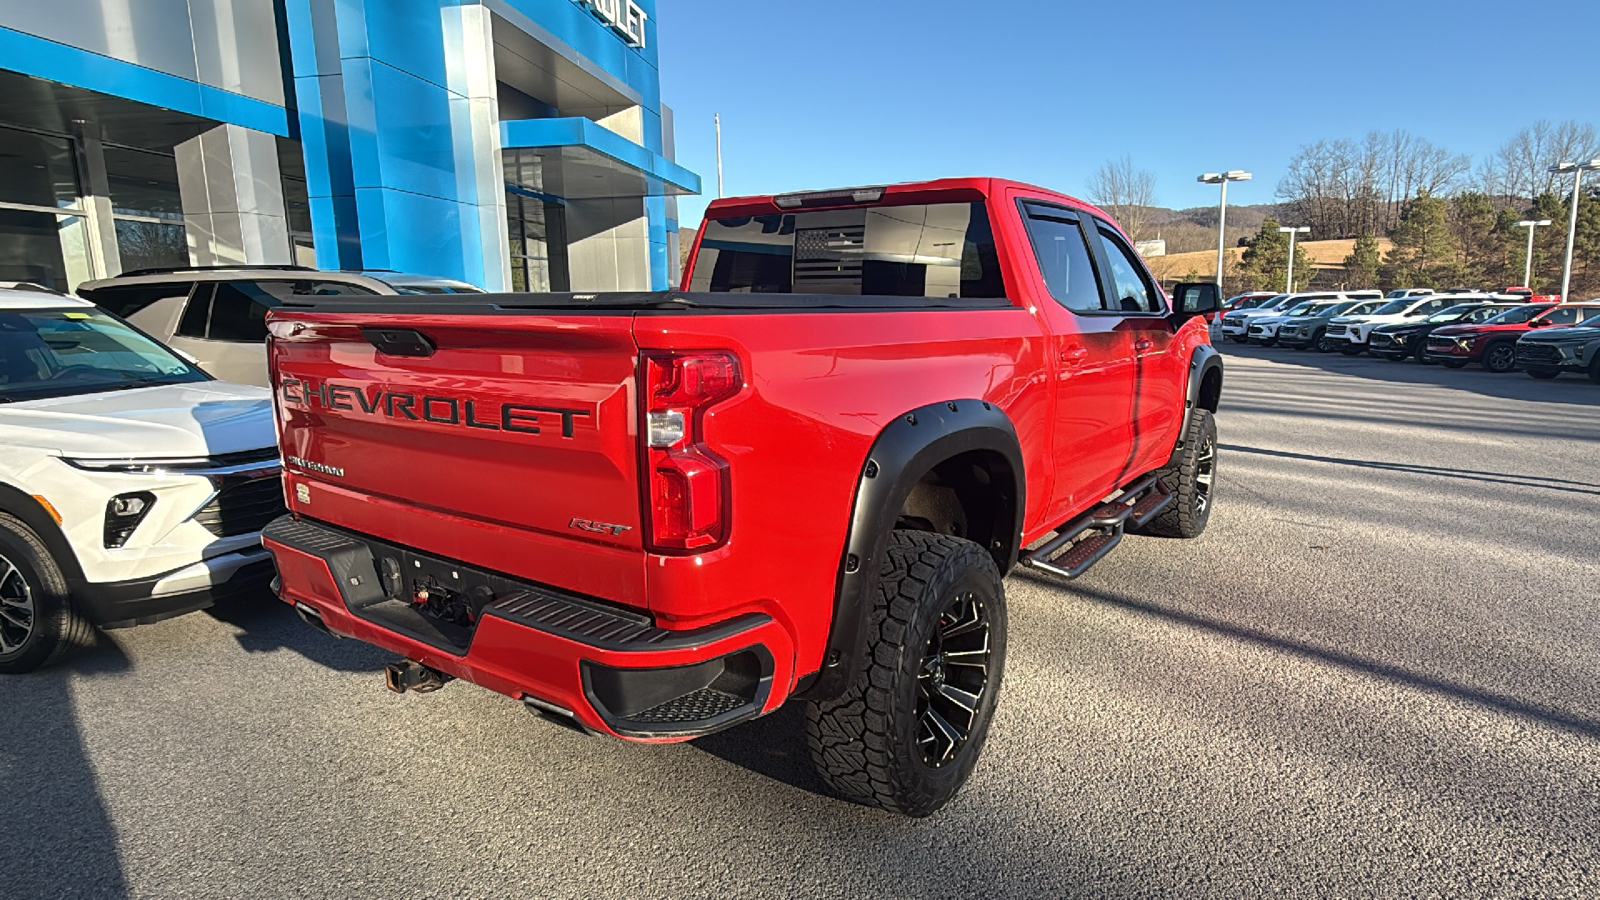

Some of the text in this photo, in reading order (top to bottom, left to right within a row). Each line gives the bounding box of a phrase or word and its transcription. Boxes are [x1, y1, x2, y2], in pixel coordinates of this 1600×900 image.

[586, 0, 647, 49] OLET
[282, 378, 591, 439] CHEVROLET
[569, 517, 633, 536] RST
